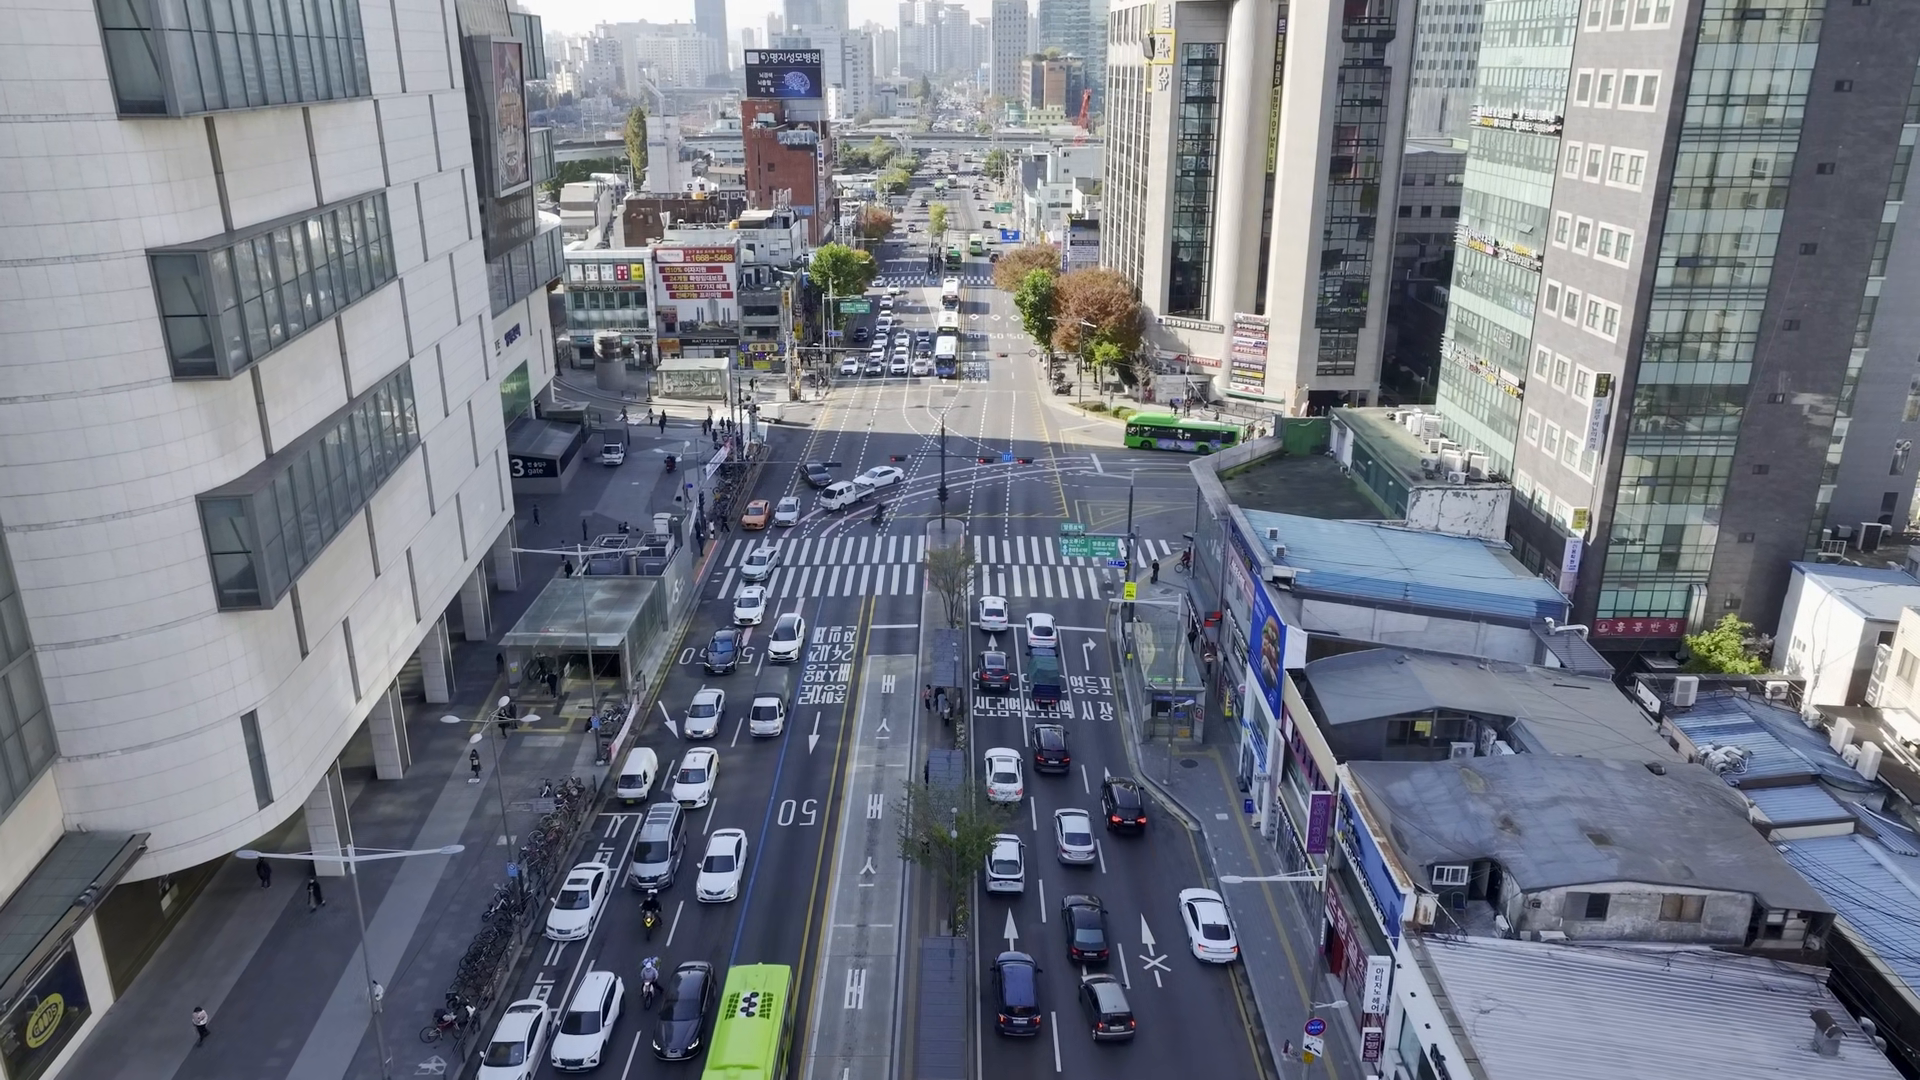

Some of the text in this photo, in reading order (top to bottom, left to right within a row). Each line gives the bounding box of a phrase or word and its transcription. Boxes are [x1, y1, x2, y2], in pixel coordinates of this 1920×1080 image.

[769, 52, 820, 64] 명지성모병원
[691, 254, 733, 262] 1668-5468
[511, 458, 525, 477] 3
[527, 468, 544, 476] gate
[813, 625, 857, 645] 전일제
[1615, 621, 1679, 633] 홍콩반점
[808, 643, 856, 662] 24시간
[803, 663, 850, 683] 버스전용
[798, 684, 847, 705] 중앙차로
[1070, 675, 1114, 696] 영등포
[973, 696, 1022, 717] 신도림역
[1082, 701, 1114, 721] 시장
[777, 799, 818, 827] 50
[1371, 968, 1384, 1012] 아티자노 헤어
[33, 1004, 58, 1036] GOODS
